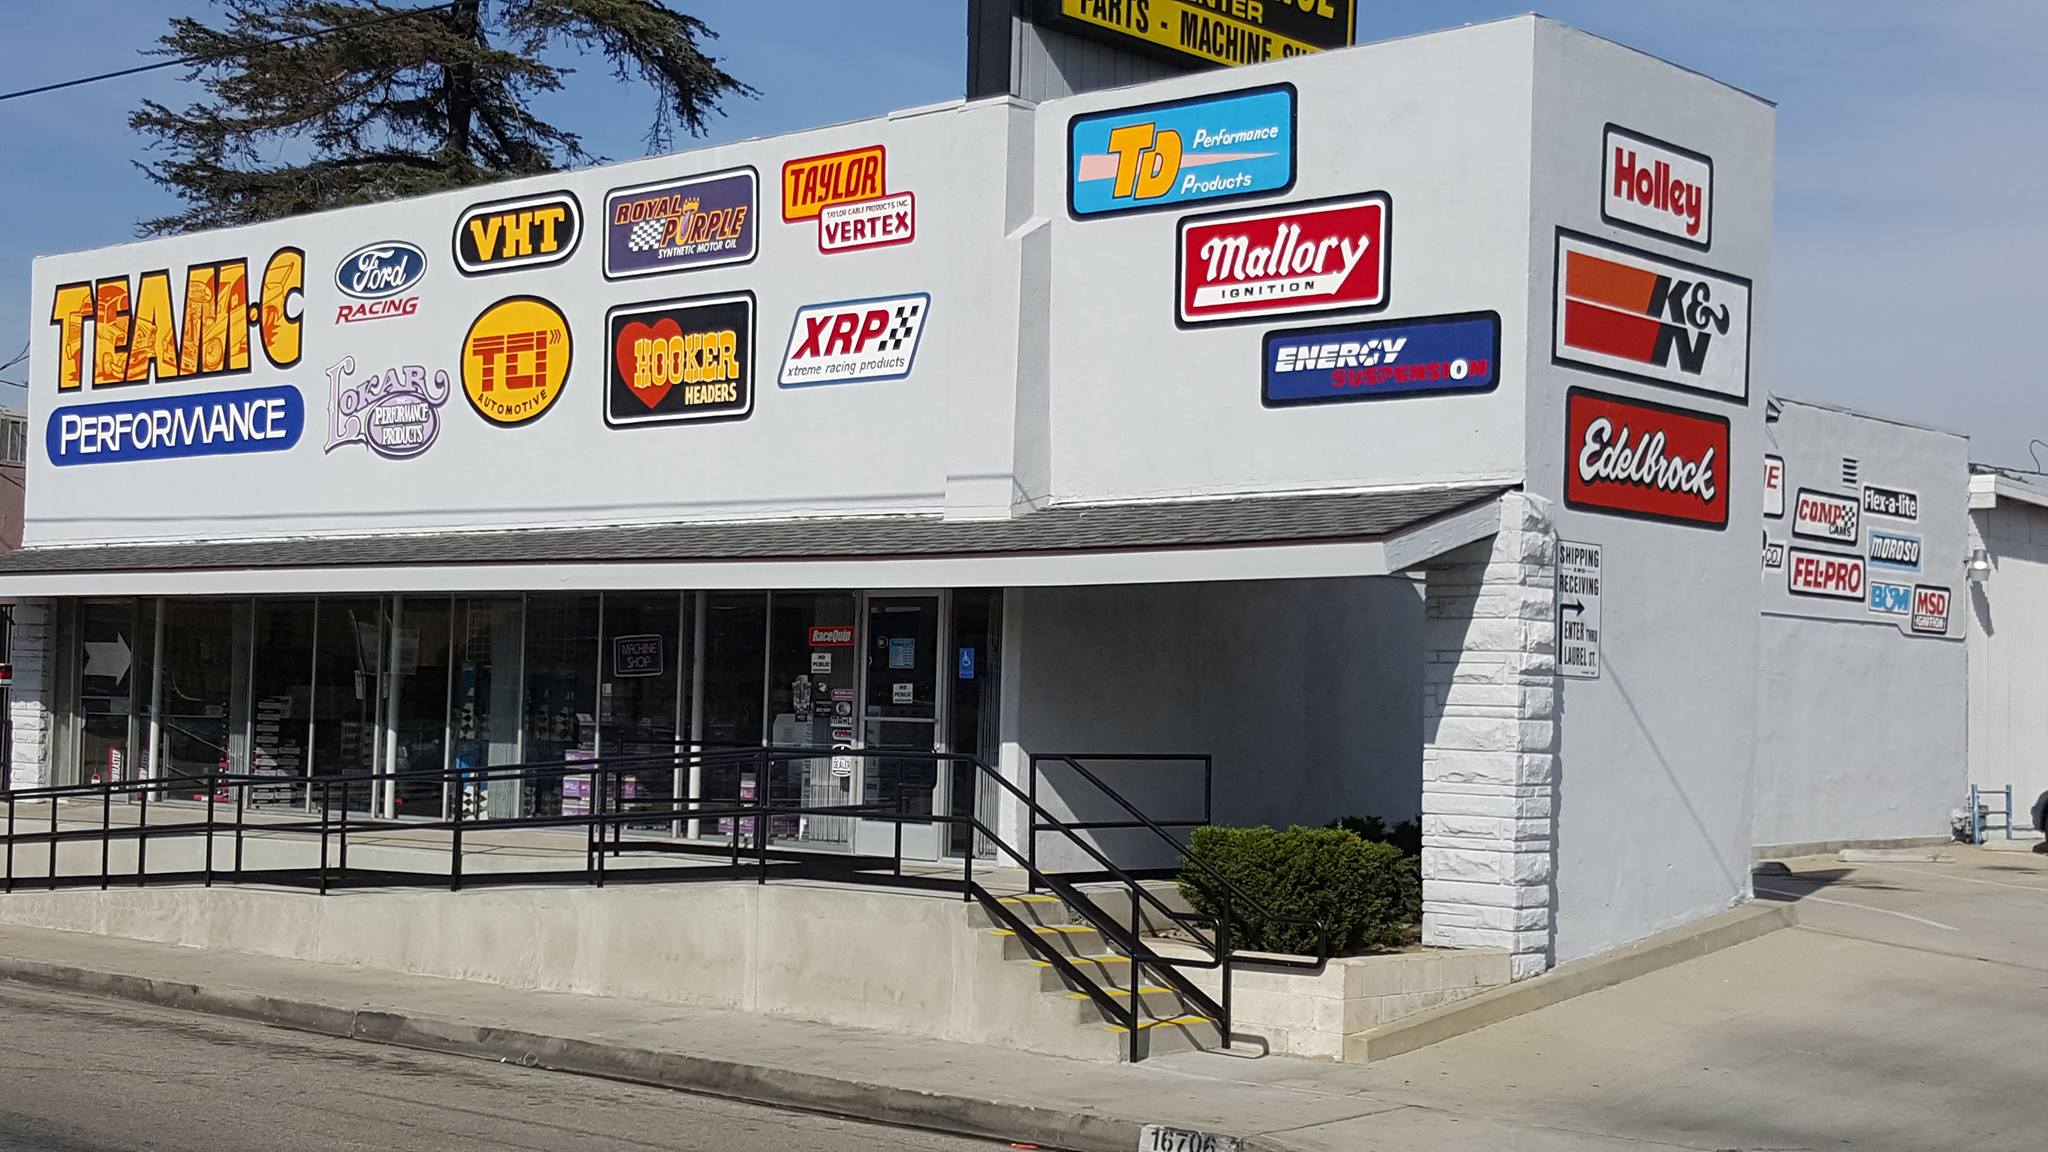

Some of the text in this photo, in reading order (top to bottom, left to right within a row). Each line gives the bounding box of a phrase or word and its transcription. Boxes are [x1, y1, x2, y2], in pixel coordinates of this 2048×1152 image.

[1180, 10, 1273, 65] MACHINE
[1192, 125, 1279, 149] Performance
[1106, 122, 1183, 200] TD
[790, 155, 879, 208] TAYLOR
[1180, 172, 1253, 195] Products
[1613, 146, 1702, 237] Holley
[615, 194, 682, 225] ROYAL
[471, 208, 566, 261] VHT
[660, 205, 748, 248] PURPLE
[825, 211, 909, 244] VERTEX
[658, 238, 737, 259] SYNTHETIC MOTOR OIL
[1200, 223, 1369, 282] Mallory
[353, 250, 406, 293] Ford
[1221, 281, 1315, 298] IGNITION
[335, 296, 420, 324] RACING
[791, 309, 890, 360] XRP
[633, 330, 739, 390] HOOKER
[787, 356, 905, 377] xtreme racing products
[1274, 338, 1406, 373] ENERGY
[1331, 360, 1487, 389] SUSPENSION
[477, 389, 548, 415] AUTOMOTIVE
[684, 383, 737, 405] HEADERS
[60, 399, 286, 455] PERFORMANCE
[374, 404, 428, 425] PERFORMANCE
[382, 426, 424, 445] PRODUCTS
[1579, 418, 1716, 501] Edelbrock
[1799, 499, 1841, 525] COMP
[1864, 490, 1917, 517] Flex-a-lite
[1828, 523, 1852, 537] CAMS
[1559, 545, 1599, 568] SHIPPING
[1559, 574, 1599, 596] RECEIVING
[1792, 557, 1861, 593] FEL-PRO
[1917, 591, 1946, 616] MSD
[1564, 620, 1585, 641] ENTER
[621, 643, 657, 655] MACHINE
[626, 656, 651, 669] SHOP
